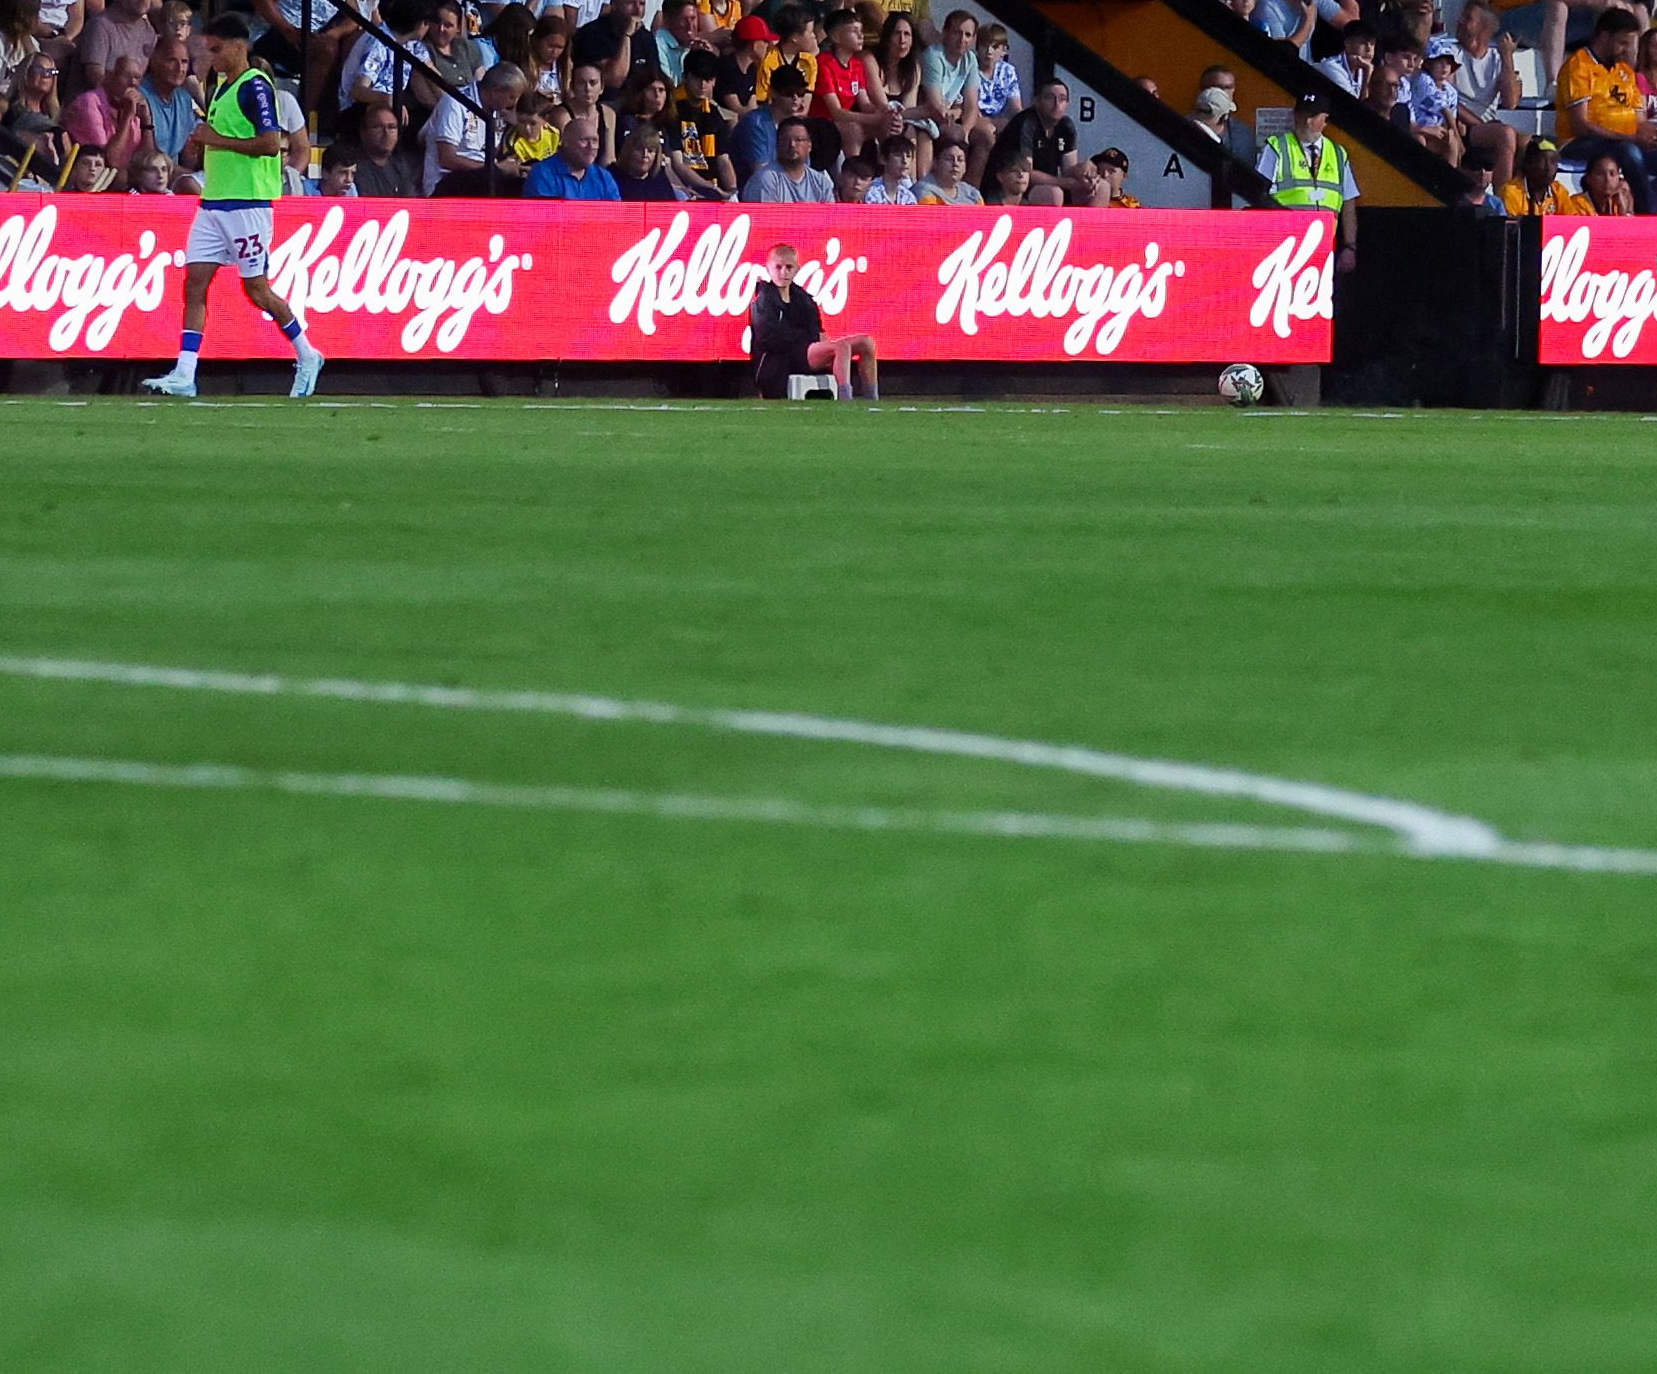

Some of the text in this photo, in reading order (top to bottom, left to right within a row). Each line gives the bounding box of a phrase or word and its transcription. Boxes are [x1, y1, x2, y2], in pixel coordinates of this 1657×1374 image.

[1080, 96, 1095, 122] B
[1163, 153, 1184, 179] A
[234, 233, 263, 258] 23
[262, 205, 520, 353] Kellogg's
[935, 213, 1172, 356] Kellogg's
